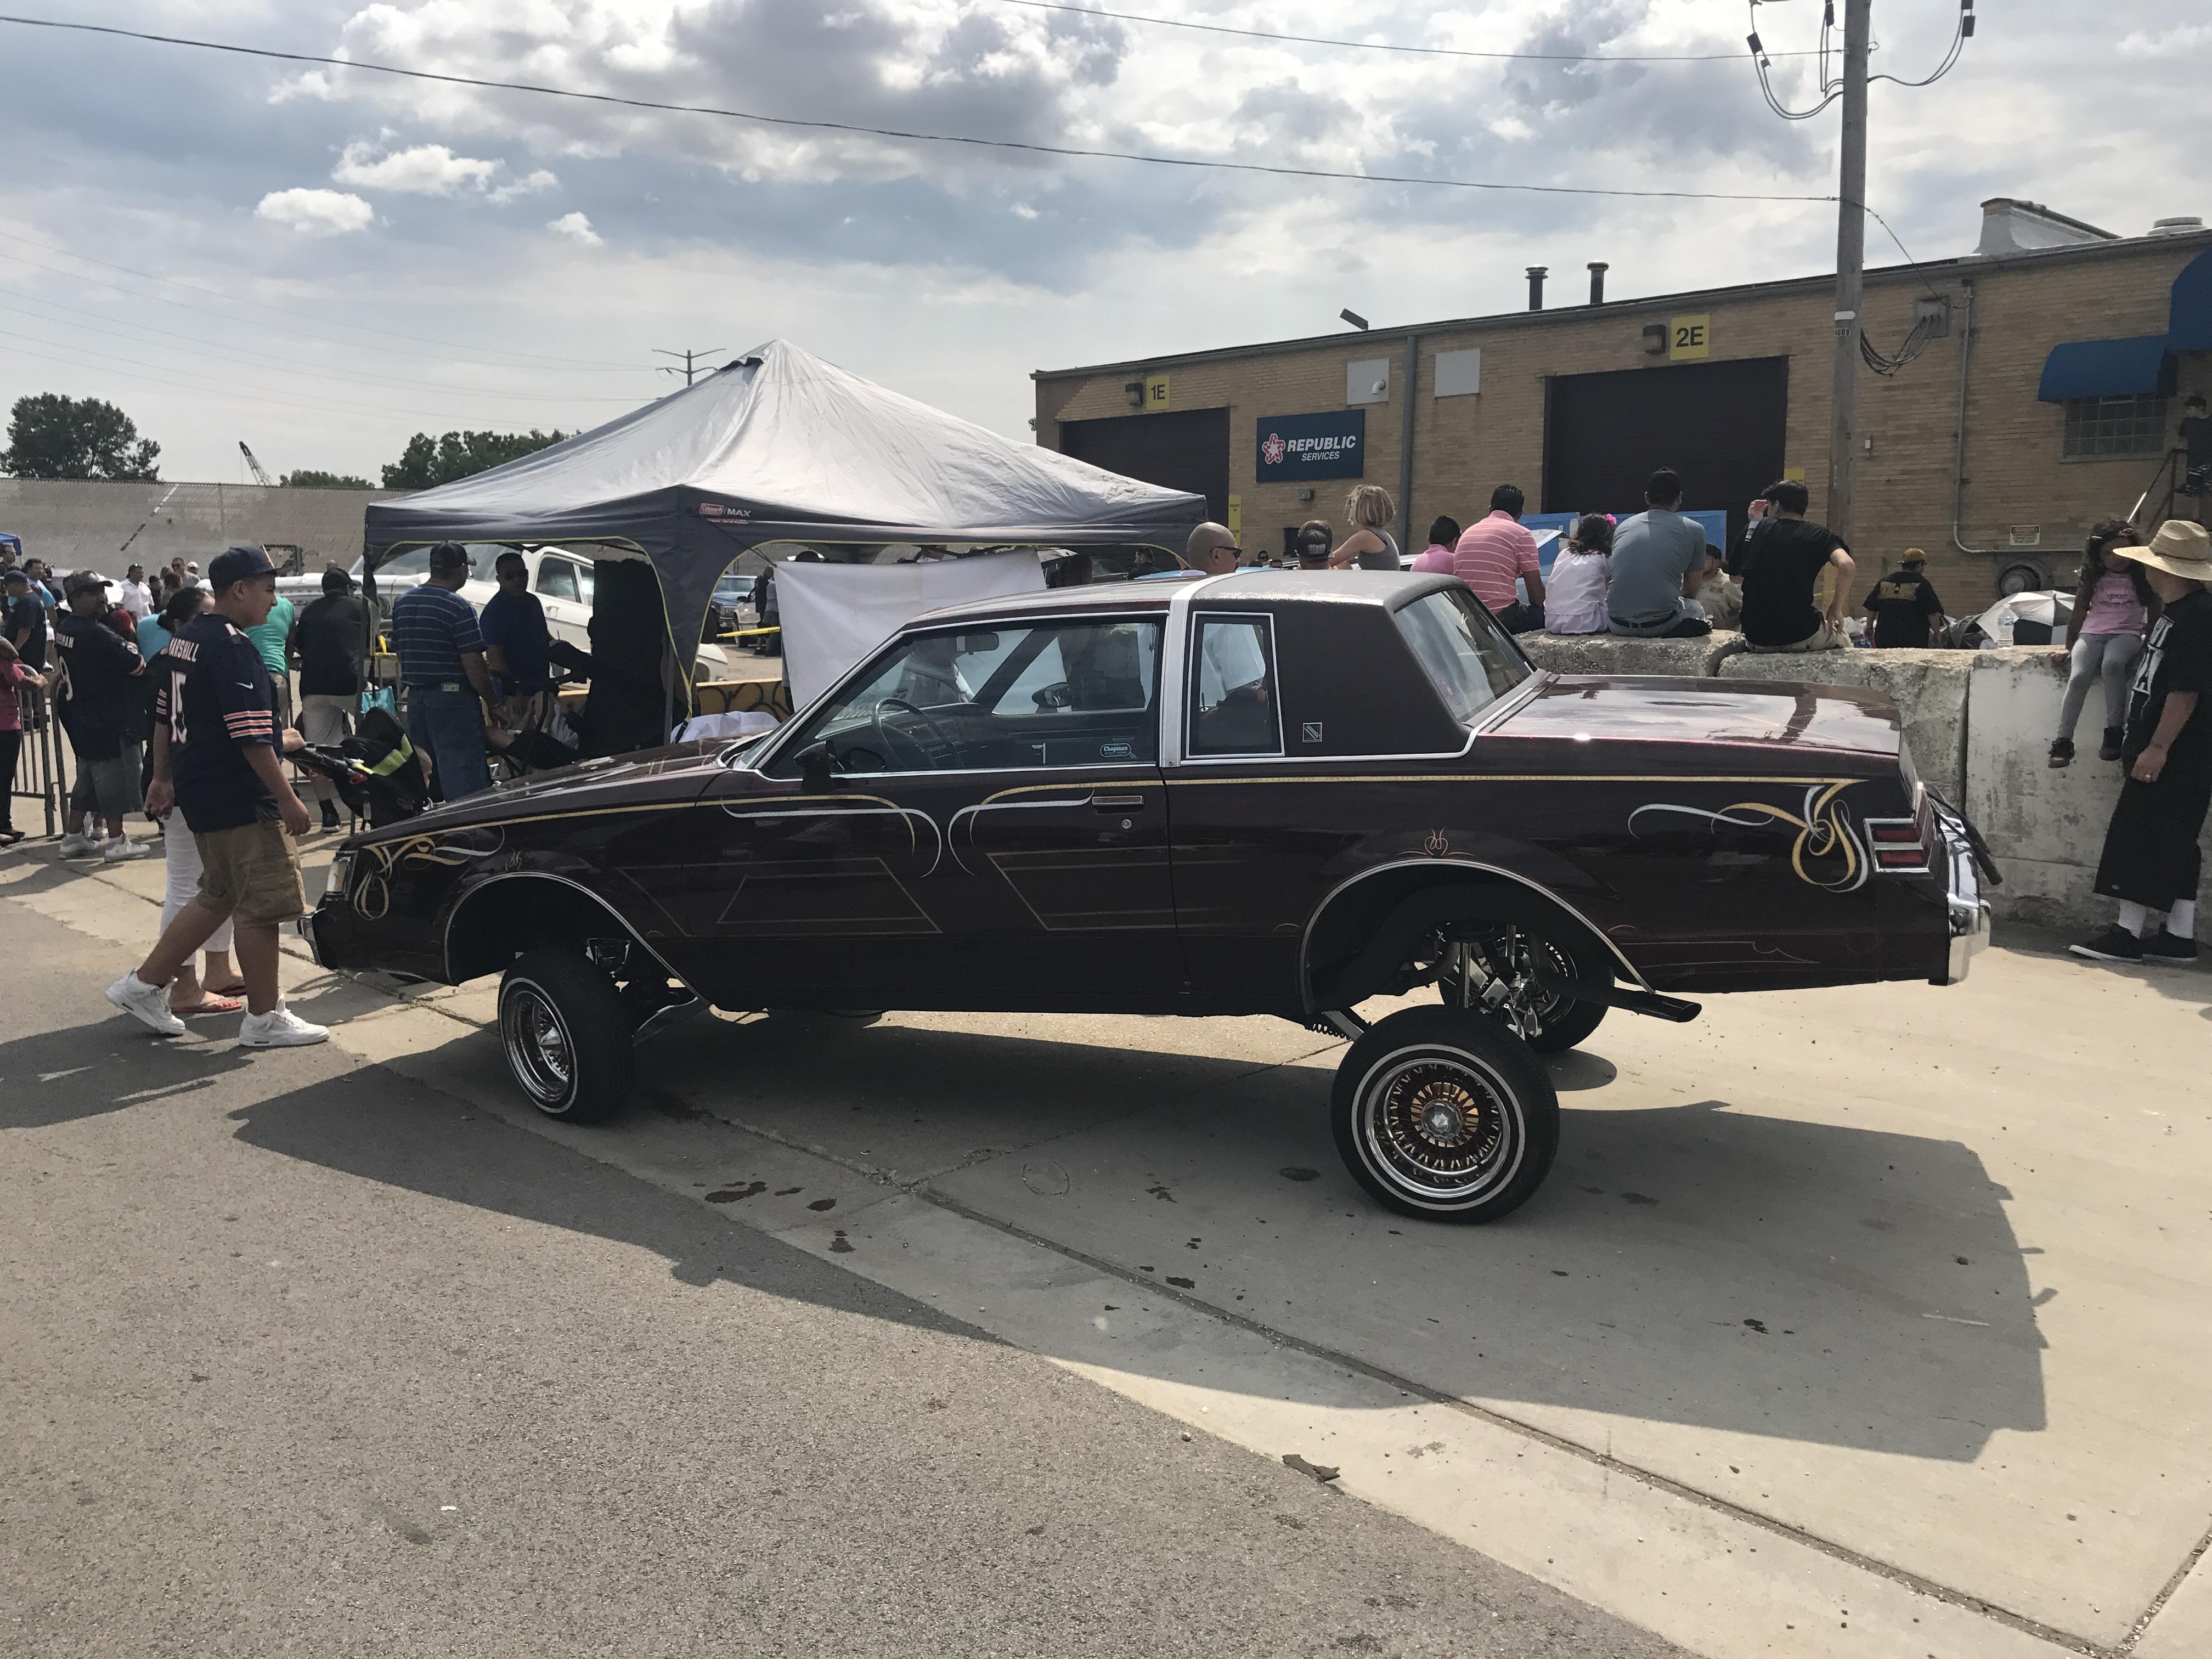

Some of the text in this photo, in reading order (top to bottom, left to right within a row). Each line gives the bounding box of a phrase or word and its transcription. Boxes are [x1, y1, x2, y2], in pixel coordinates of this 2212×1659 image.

[1675, 326, 1704, 348] 2E
[1150, 384, 1165, 400] 1E
[1287, 435, 1356, 452] REPUBLIC
[1301, 451, 1340, 461] SERVICES
